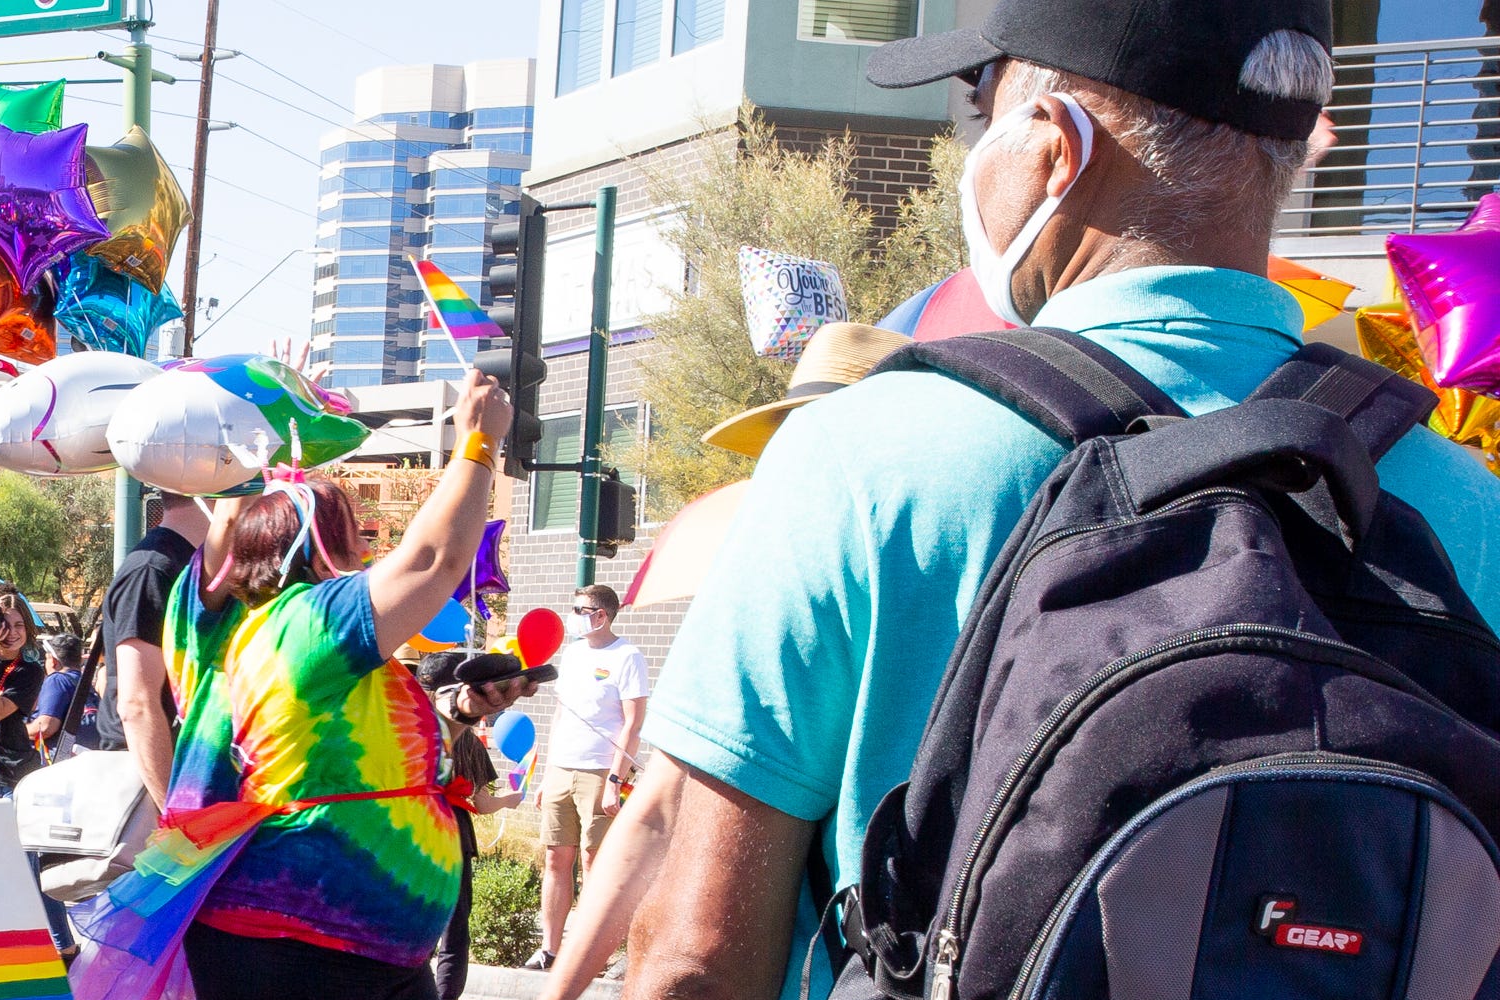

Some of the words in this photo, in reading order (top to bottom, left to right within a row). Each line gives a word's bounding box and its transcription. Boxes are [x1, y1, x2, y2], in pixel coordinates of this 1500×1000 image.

[777, 267, 838, 306] You're
[1260, 900, 1294, 930] F
[1286, 927, 1351, 951] GEAR
